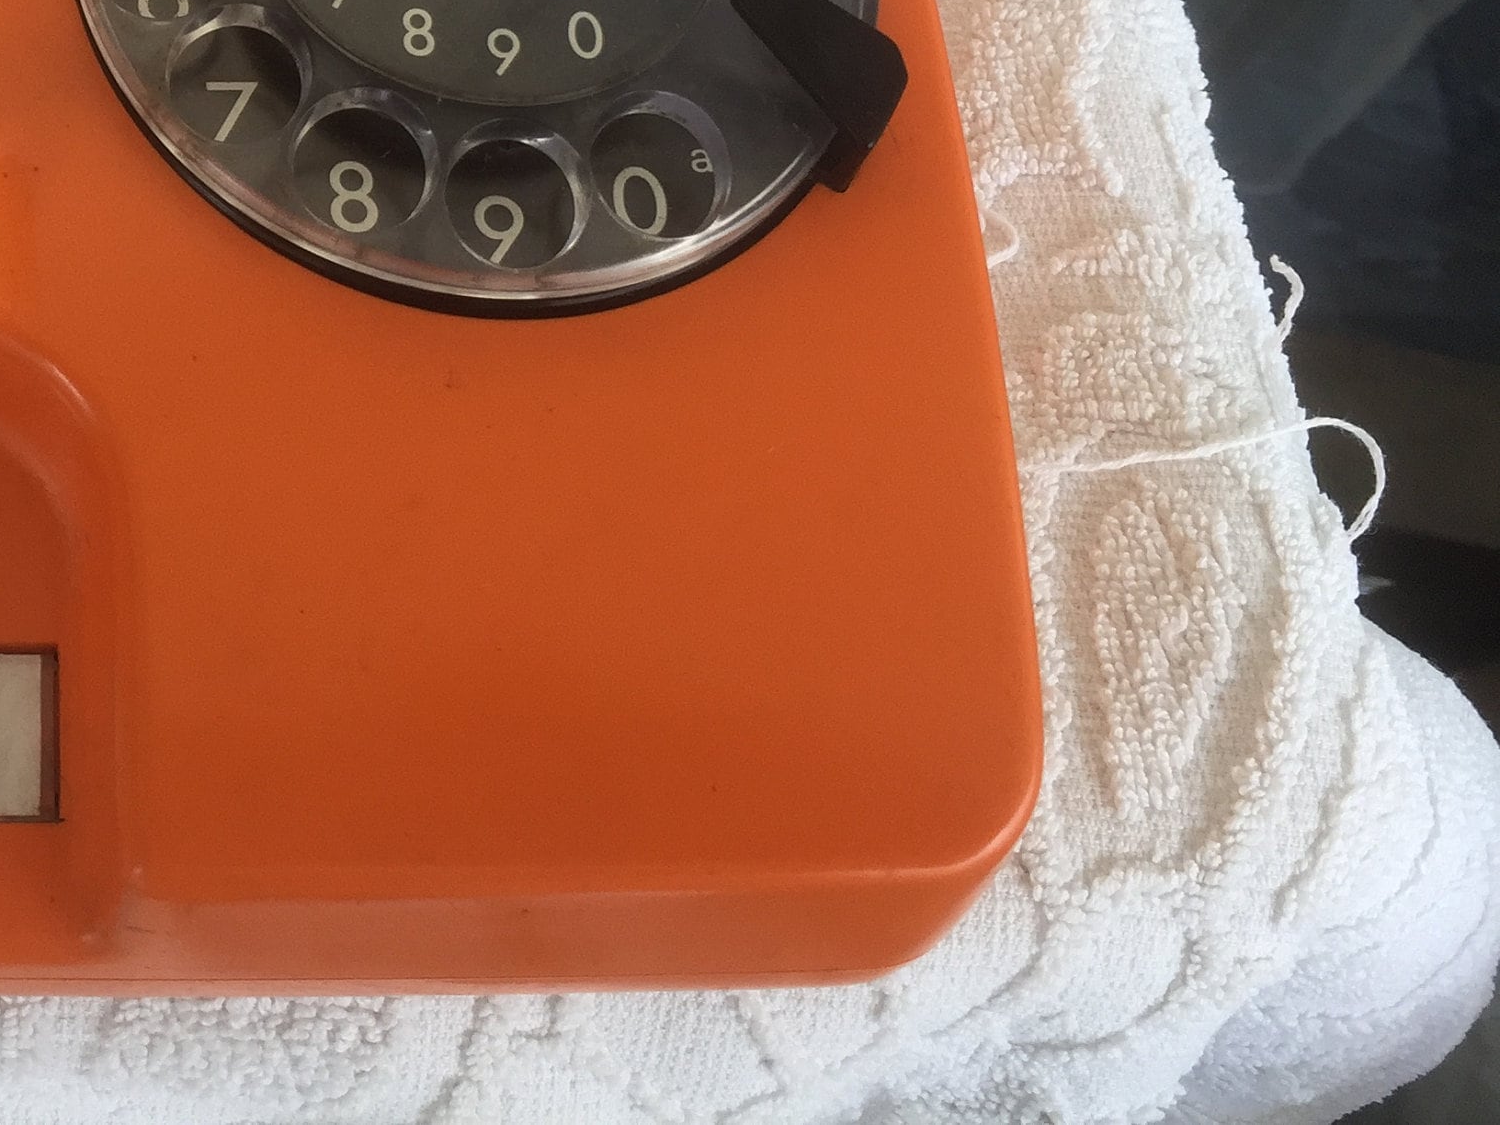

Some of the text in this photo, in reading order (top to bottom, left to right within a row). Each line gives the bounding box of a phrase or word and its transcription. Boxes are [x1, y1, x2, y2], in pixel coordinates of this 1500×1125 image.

[402, 8, 436, 57] 8
[487, 28, 521, 76] 9
[567, 11, 604, 60] 0
[206, 81, 258, 143] 7
[329, 160, 379, 233] 8
[612, 166, 668, 236] 0
[473, 195, 525, 264] 9
